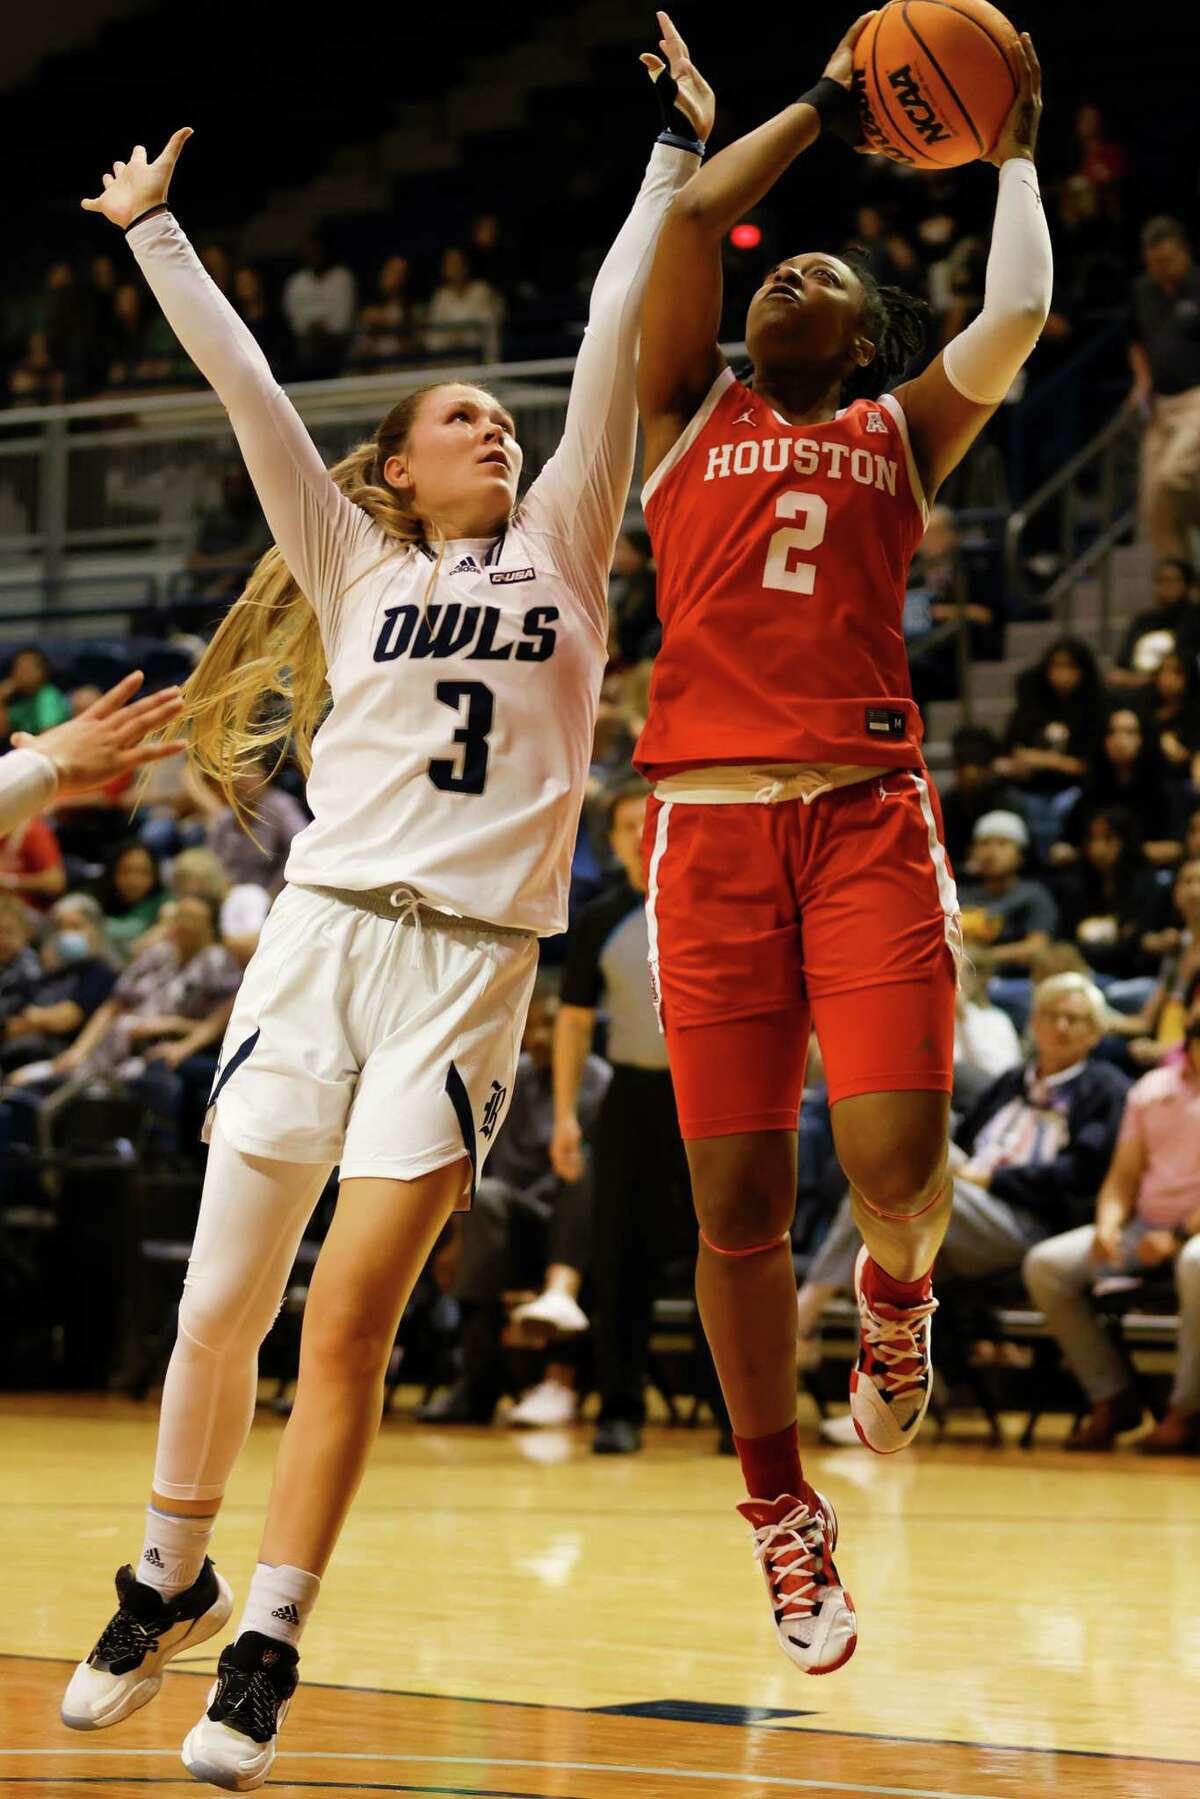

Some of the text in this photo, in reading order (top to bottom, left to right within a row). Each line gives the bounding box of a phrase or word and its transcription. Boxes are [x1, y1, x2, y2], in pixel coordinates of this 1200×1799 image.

[888, 64, 952, 145] NCAA
[704, 438, 898, 496] HOUSTON
[449, 565, 481, 576] adidas
[762, 490, 827, 595] 2
[373, 603, 560, 663] OWLS
[427, 681, 494, 795] 3
